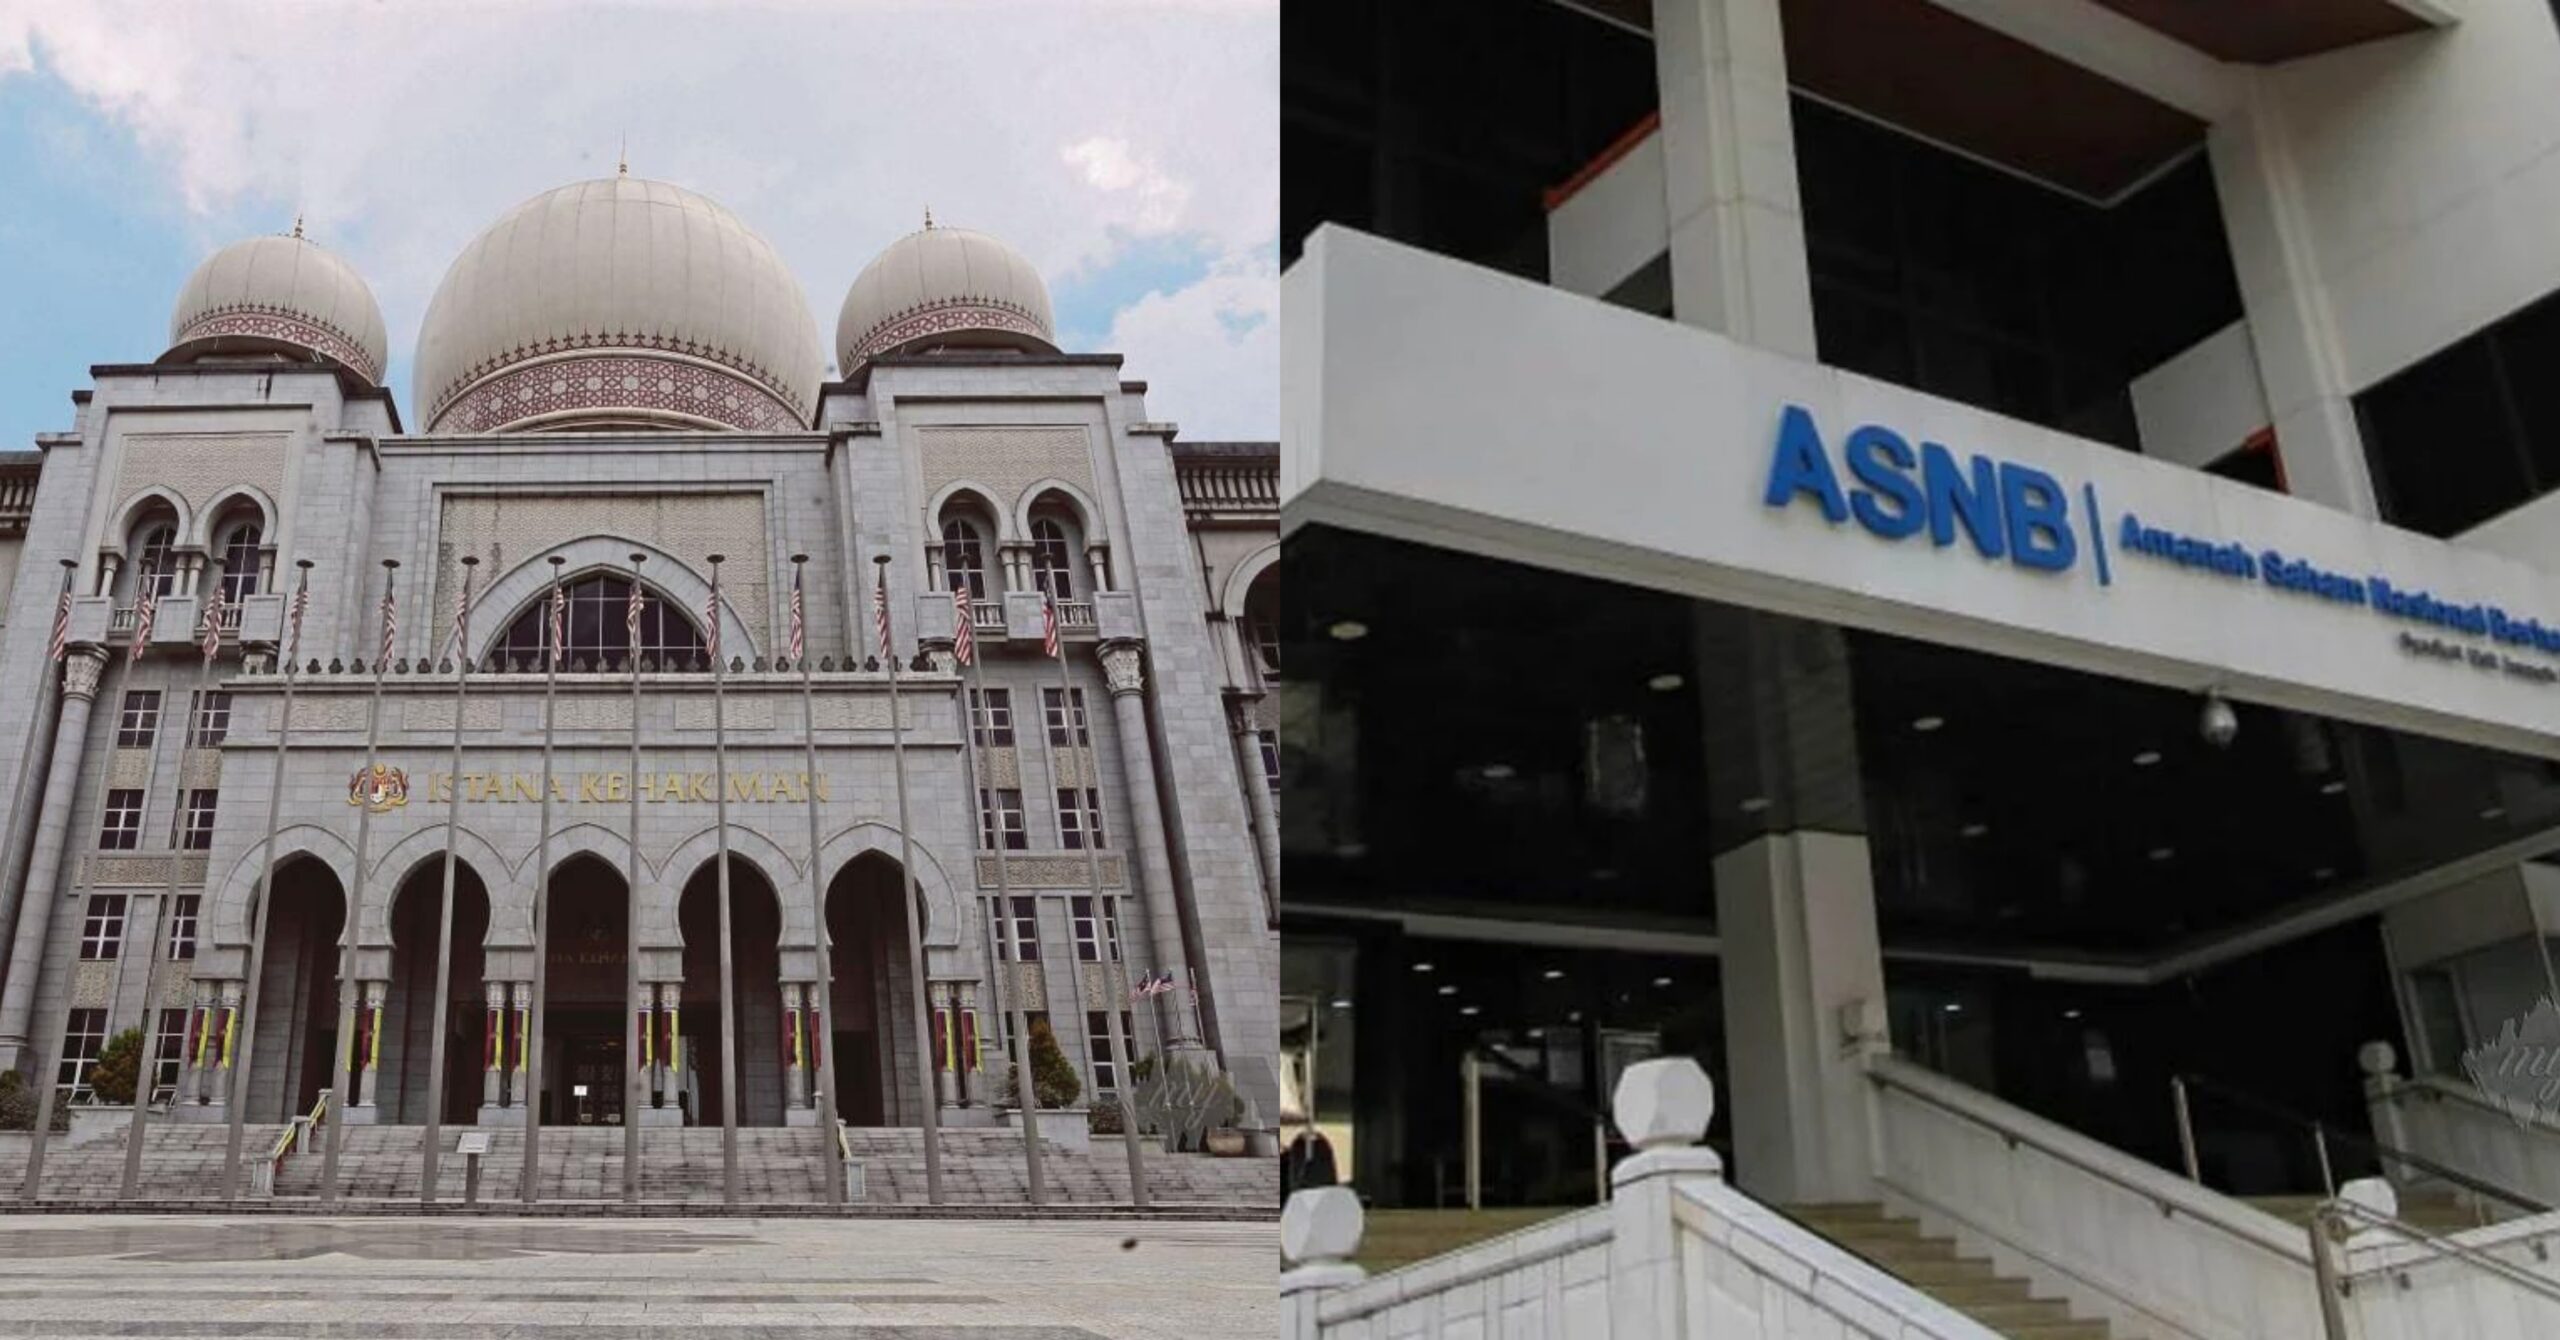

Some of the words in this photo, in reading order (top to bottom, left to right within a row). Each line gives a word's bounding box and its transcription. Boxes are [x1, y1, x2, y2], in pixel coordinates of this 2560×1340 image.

[1763, 404, 2077, 571] ASNB
[2121, 513, 2256, 579] Amanah
[2262, 550, 2365, 605] Saham
[579, 772, 828, 803] KEHAKMAN
